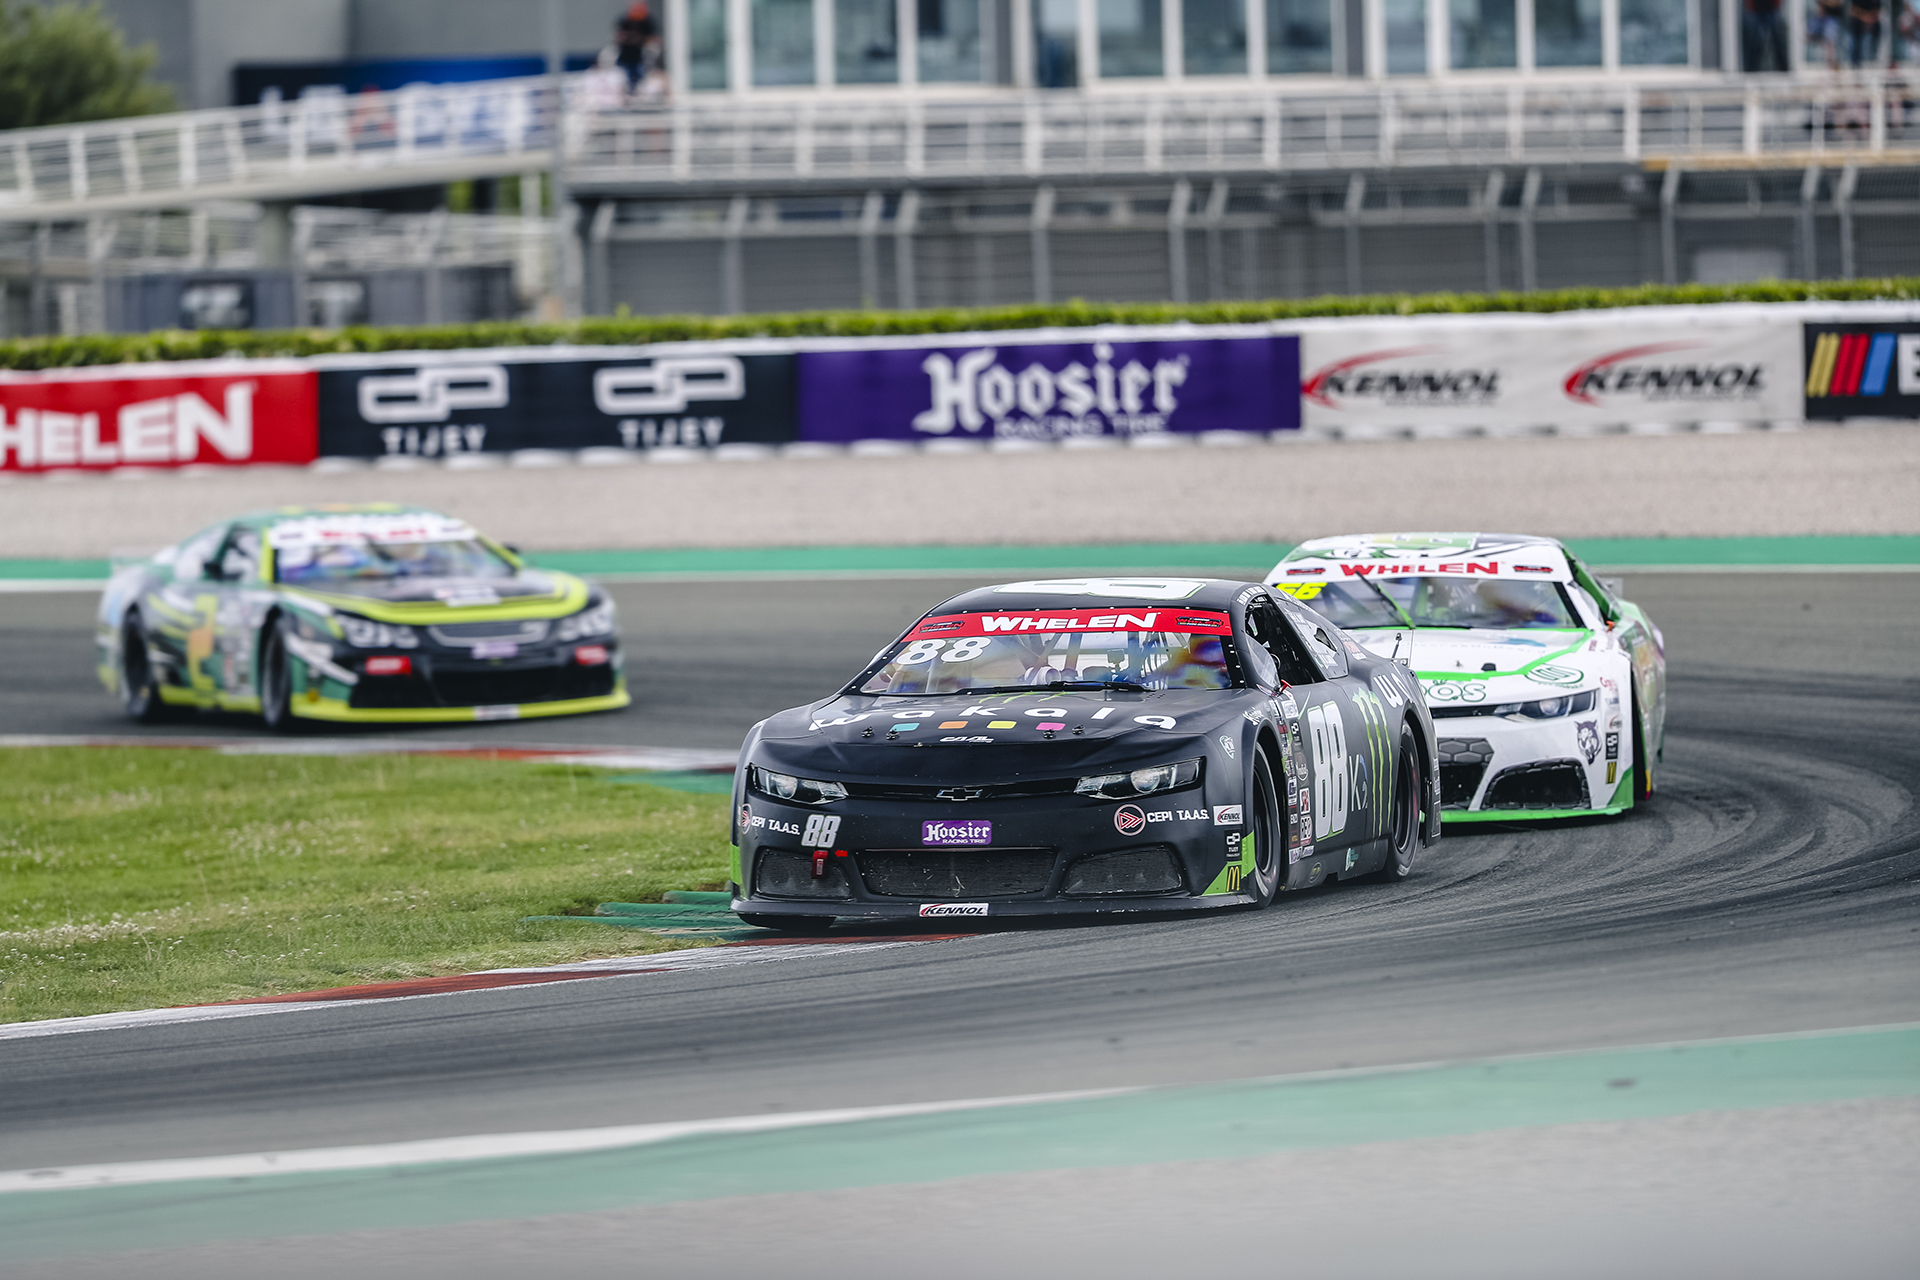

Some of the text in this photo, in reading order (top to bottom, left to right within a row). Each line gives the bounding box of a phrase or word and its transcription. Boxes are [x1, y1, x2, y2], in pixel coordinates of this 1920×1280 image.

[910, 342, 1188, 434] Hoosier
[1324, 369, 1498, 396] KENNOL
[1581, 364, 1764, 391] KENNOL
[1340, 562, 1498, 576] WHELEN
[981, 612, 1157, 632] WHELEN
[897, 637, 991, 665] 88
[809, 705, 1177, 730] wakala
[1307, 700, 1349, 841] 88
[751, 815, 766, 828] CEPI
[1147, 811, 1173, 822] CEPI
[801, 814, 841, 848] 88
[923, 822, 990, 841] Hoosier
[925, 907, 983, 915] KENNOL
